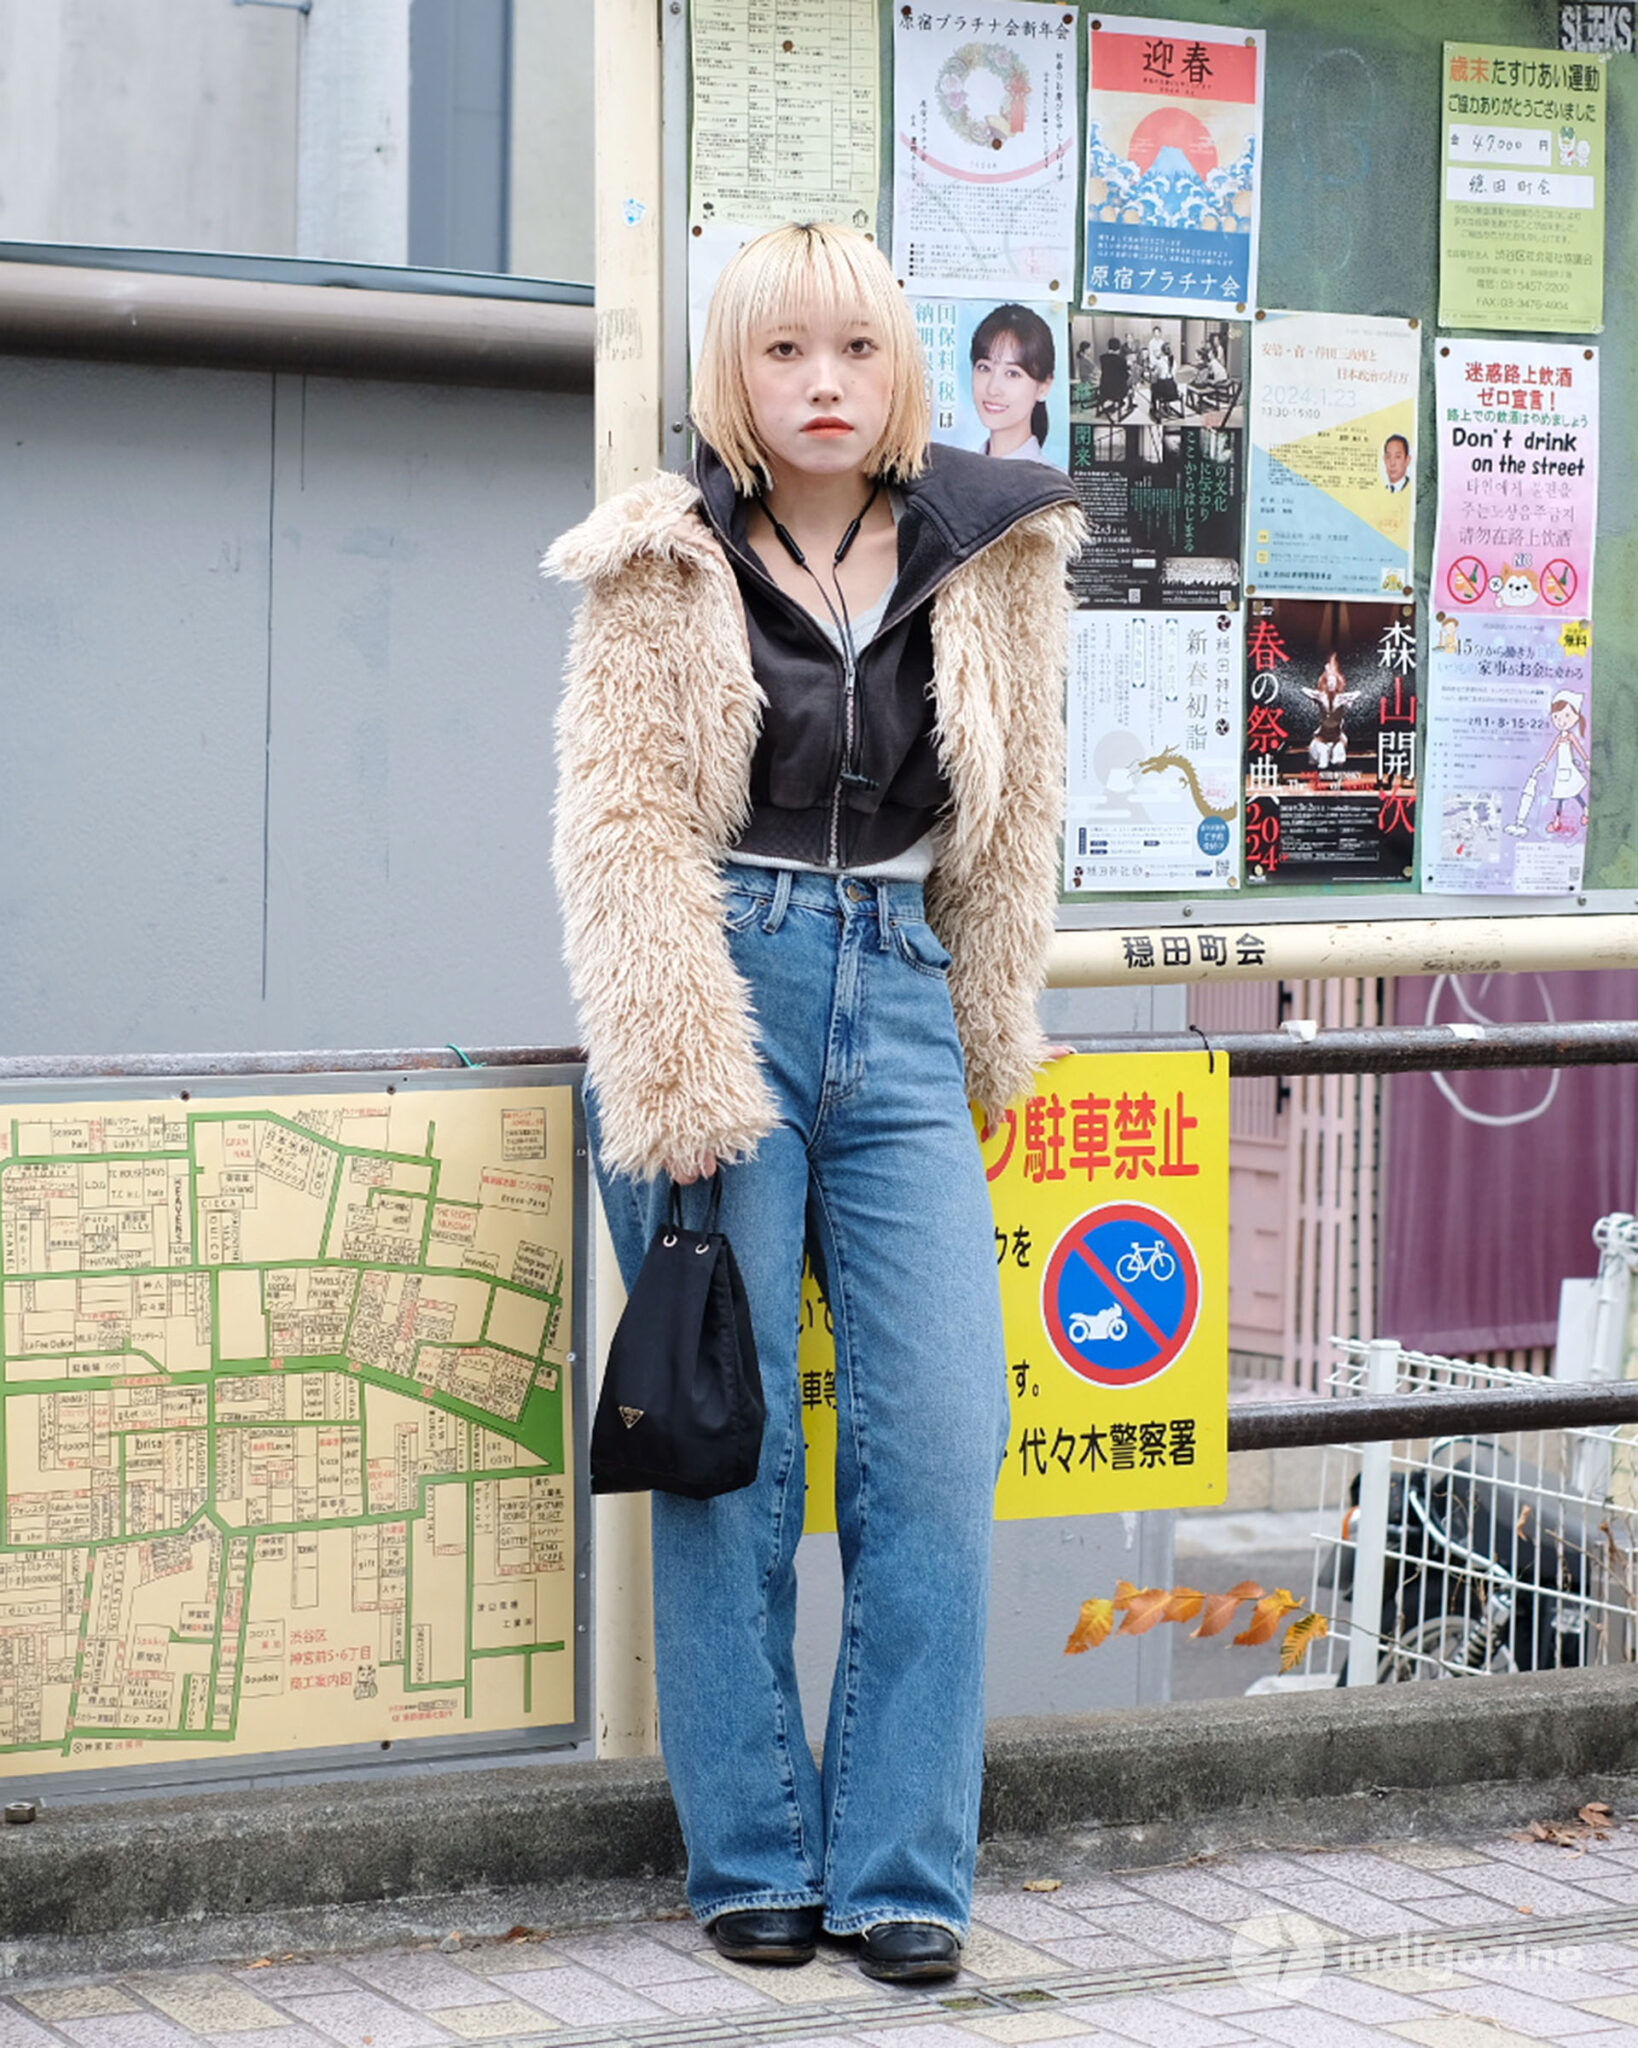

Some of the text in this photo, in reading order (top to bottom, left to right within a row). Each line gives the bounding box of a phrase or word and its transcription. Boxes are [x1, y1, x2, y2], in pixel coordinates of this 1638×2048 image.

[900, 13, 1069, 40] 原宿プラチナ会新年会
[1143, 40, 1213, 84] 迎春
[1450, 55, 1600, 92] 歳末たすけあい運動
[1448, 94, 1597, 122] ご協力ありがとうございました
[1539, 139, 1549, 151] 円
[1091, 265, 1241, 298] 原宿プラチナ会
[1465, 362, 1573, 388] 迷惑路上飲酒
[1477, 387, 1556, 412] ゼロ宣言！
[1447, 408, 1589, 428] 路上での飲酒はやめましょう
[1452, 427, 1577, 452] Don't drink
[1471, 454, 1586, 477] on the street
[1186, 628, 1208, 751] 新春初詣
[1247, 620, 1291, 805] 春の祭典
[1377, 621, 1418, 834] 森山開次
[1121, 933, 1266, 969] 穏田町会
[1018, 1418, 1197, 1476] 代々木警察署
[290, 1629, 328, 1645] 渋谷区
[290, 1672, 351, 1691] 商工案内図
